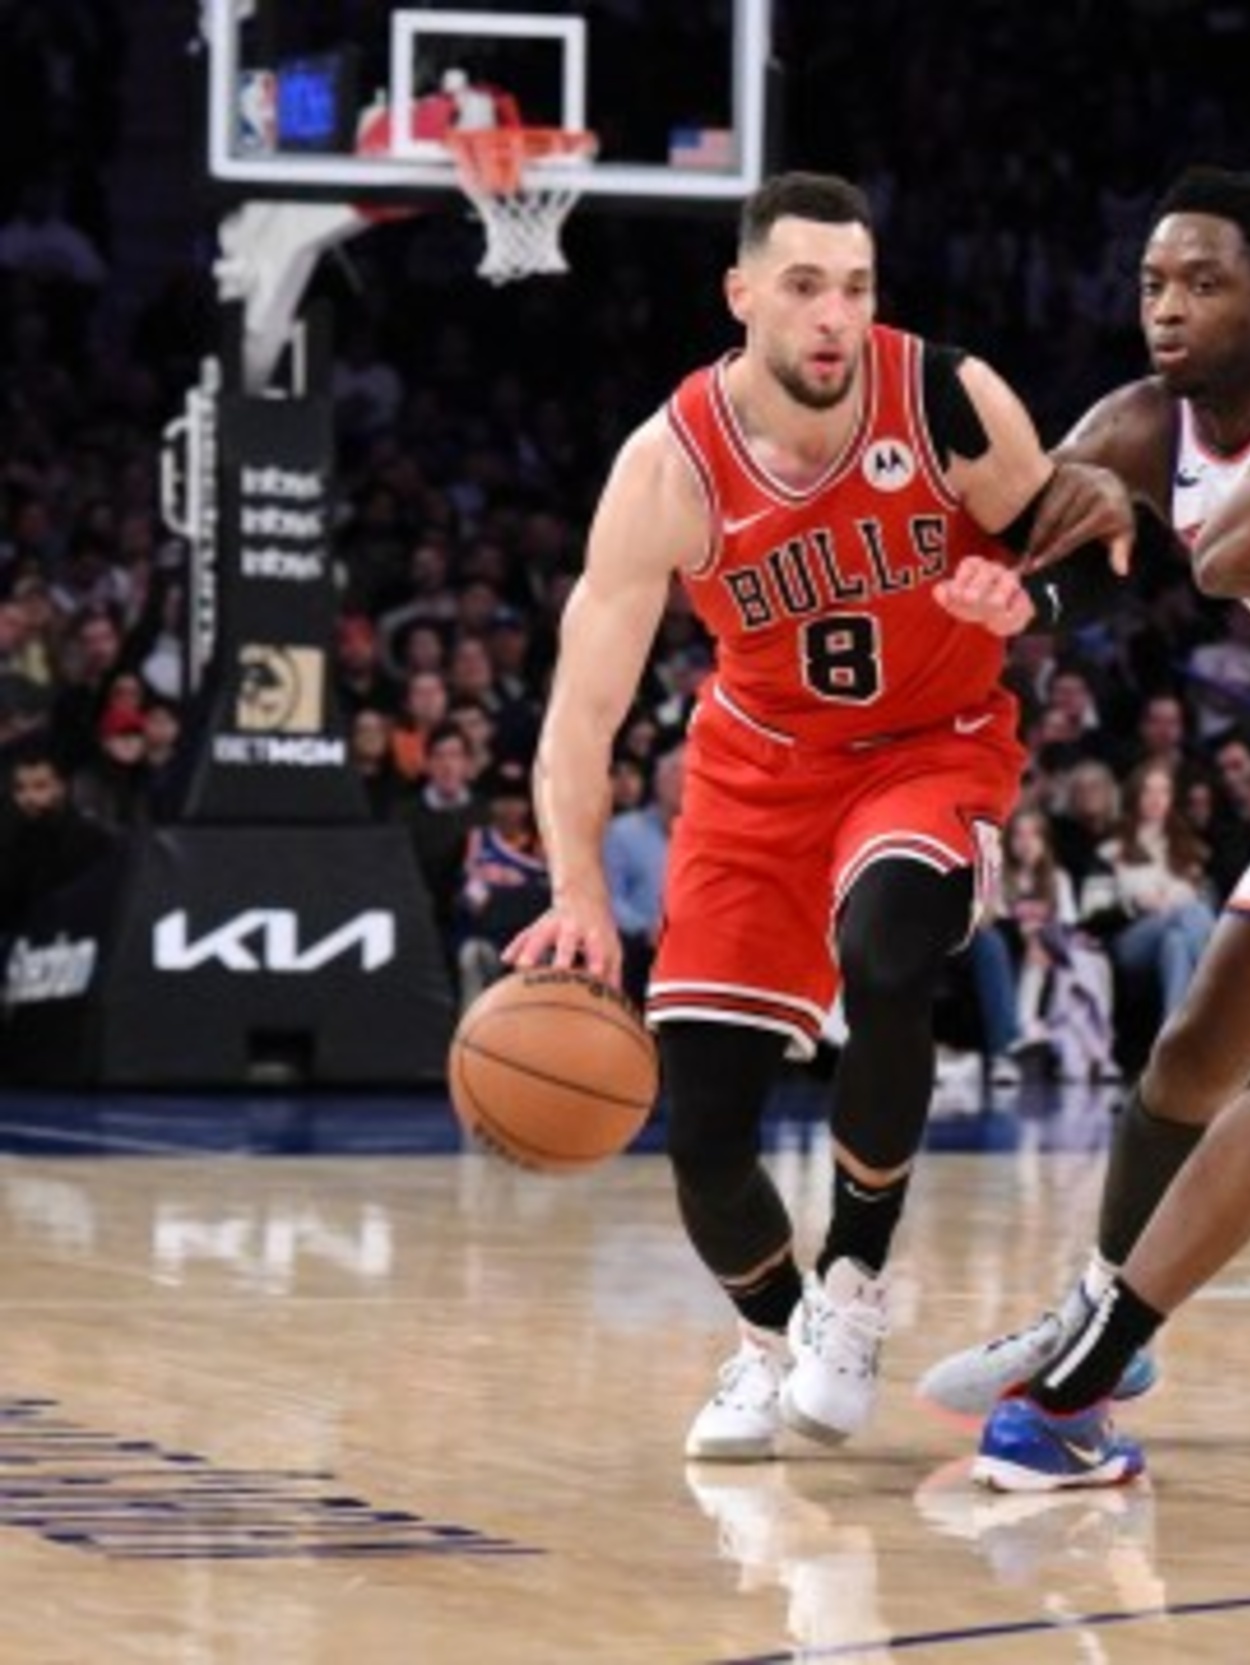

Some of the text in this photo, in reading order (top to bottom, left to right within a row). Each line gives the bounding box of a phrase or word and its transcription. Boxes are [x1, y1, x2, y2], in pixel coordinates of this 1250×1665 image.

[722, 514, 946, 632] BULLS
[799, 612, 882, 706] 8
[153, 909, 394, 971] KIA
